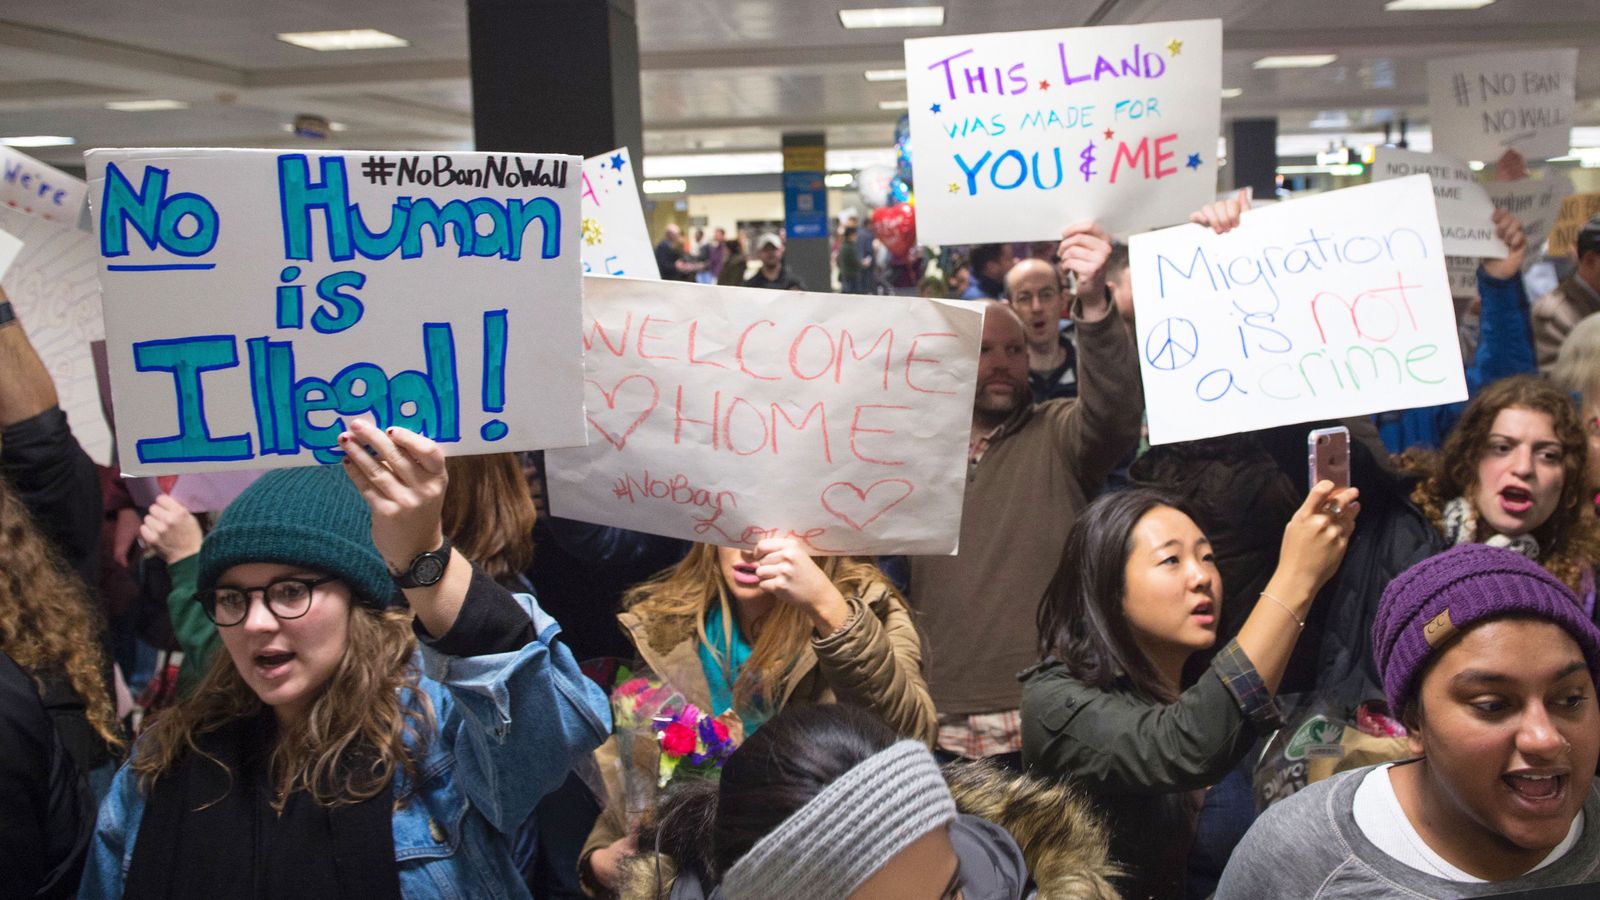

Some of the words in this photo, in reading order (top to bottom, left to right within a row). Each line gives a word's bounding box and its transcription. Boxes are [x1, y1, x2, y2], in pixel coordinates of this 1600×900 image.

[928, 48, 1028, 100] THIS
[1058, 42, 1166, 86] LAND
[1522, 70, 1561, 95] BAN
[943, 113, 1006, 139] WAS
[1020, 105, 1096, 132] MADE
[1114, 97, 1161, 121] FOR
[1482, 107, 1516, 134] NO
[361, 155, 568, 189] #NoBanNoWall
[953, 147, 1064, 196] YOU
[1109, 133, 1178, 184] ME
[1386, 162, 1409, 177] NO
[1413, 163, 1448, 178] HATE
[1432, 185, 1462, 200] AME
[100, 161, 220, 258] No
[277, 153, 562, 263] Human
[275, 264, 367, 334] is
[1157, 227, 1428, 317] Migration
[1238, 312, 1292, 359] is
[1310, 271, 1424, 344] not
[583, 311, 960, 396] WELCOME
[1196, 368, 1248, 402] a
[1258, 343, 1448, 402] crime
[673, 384, 914, 467] HOME
